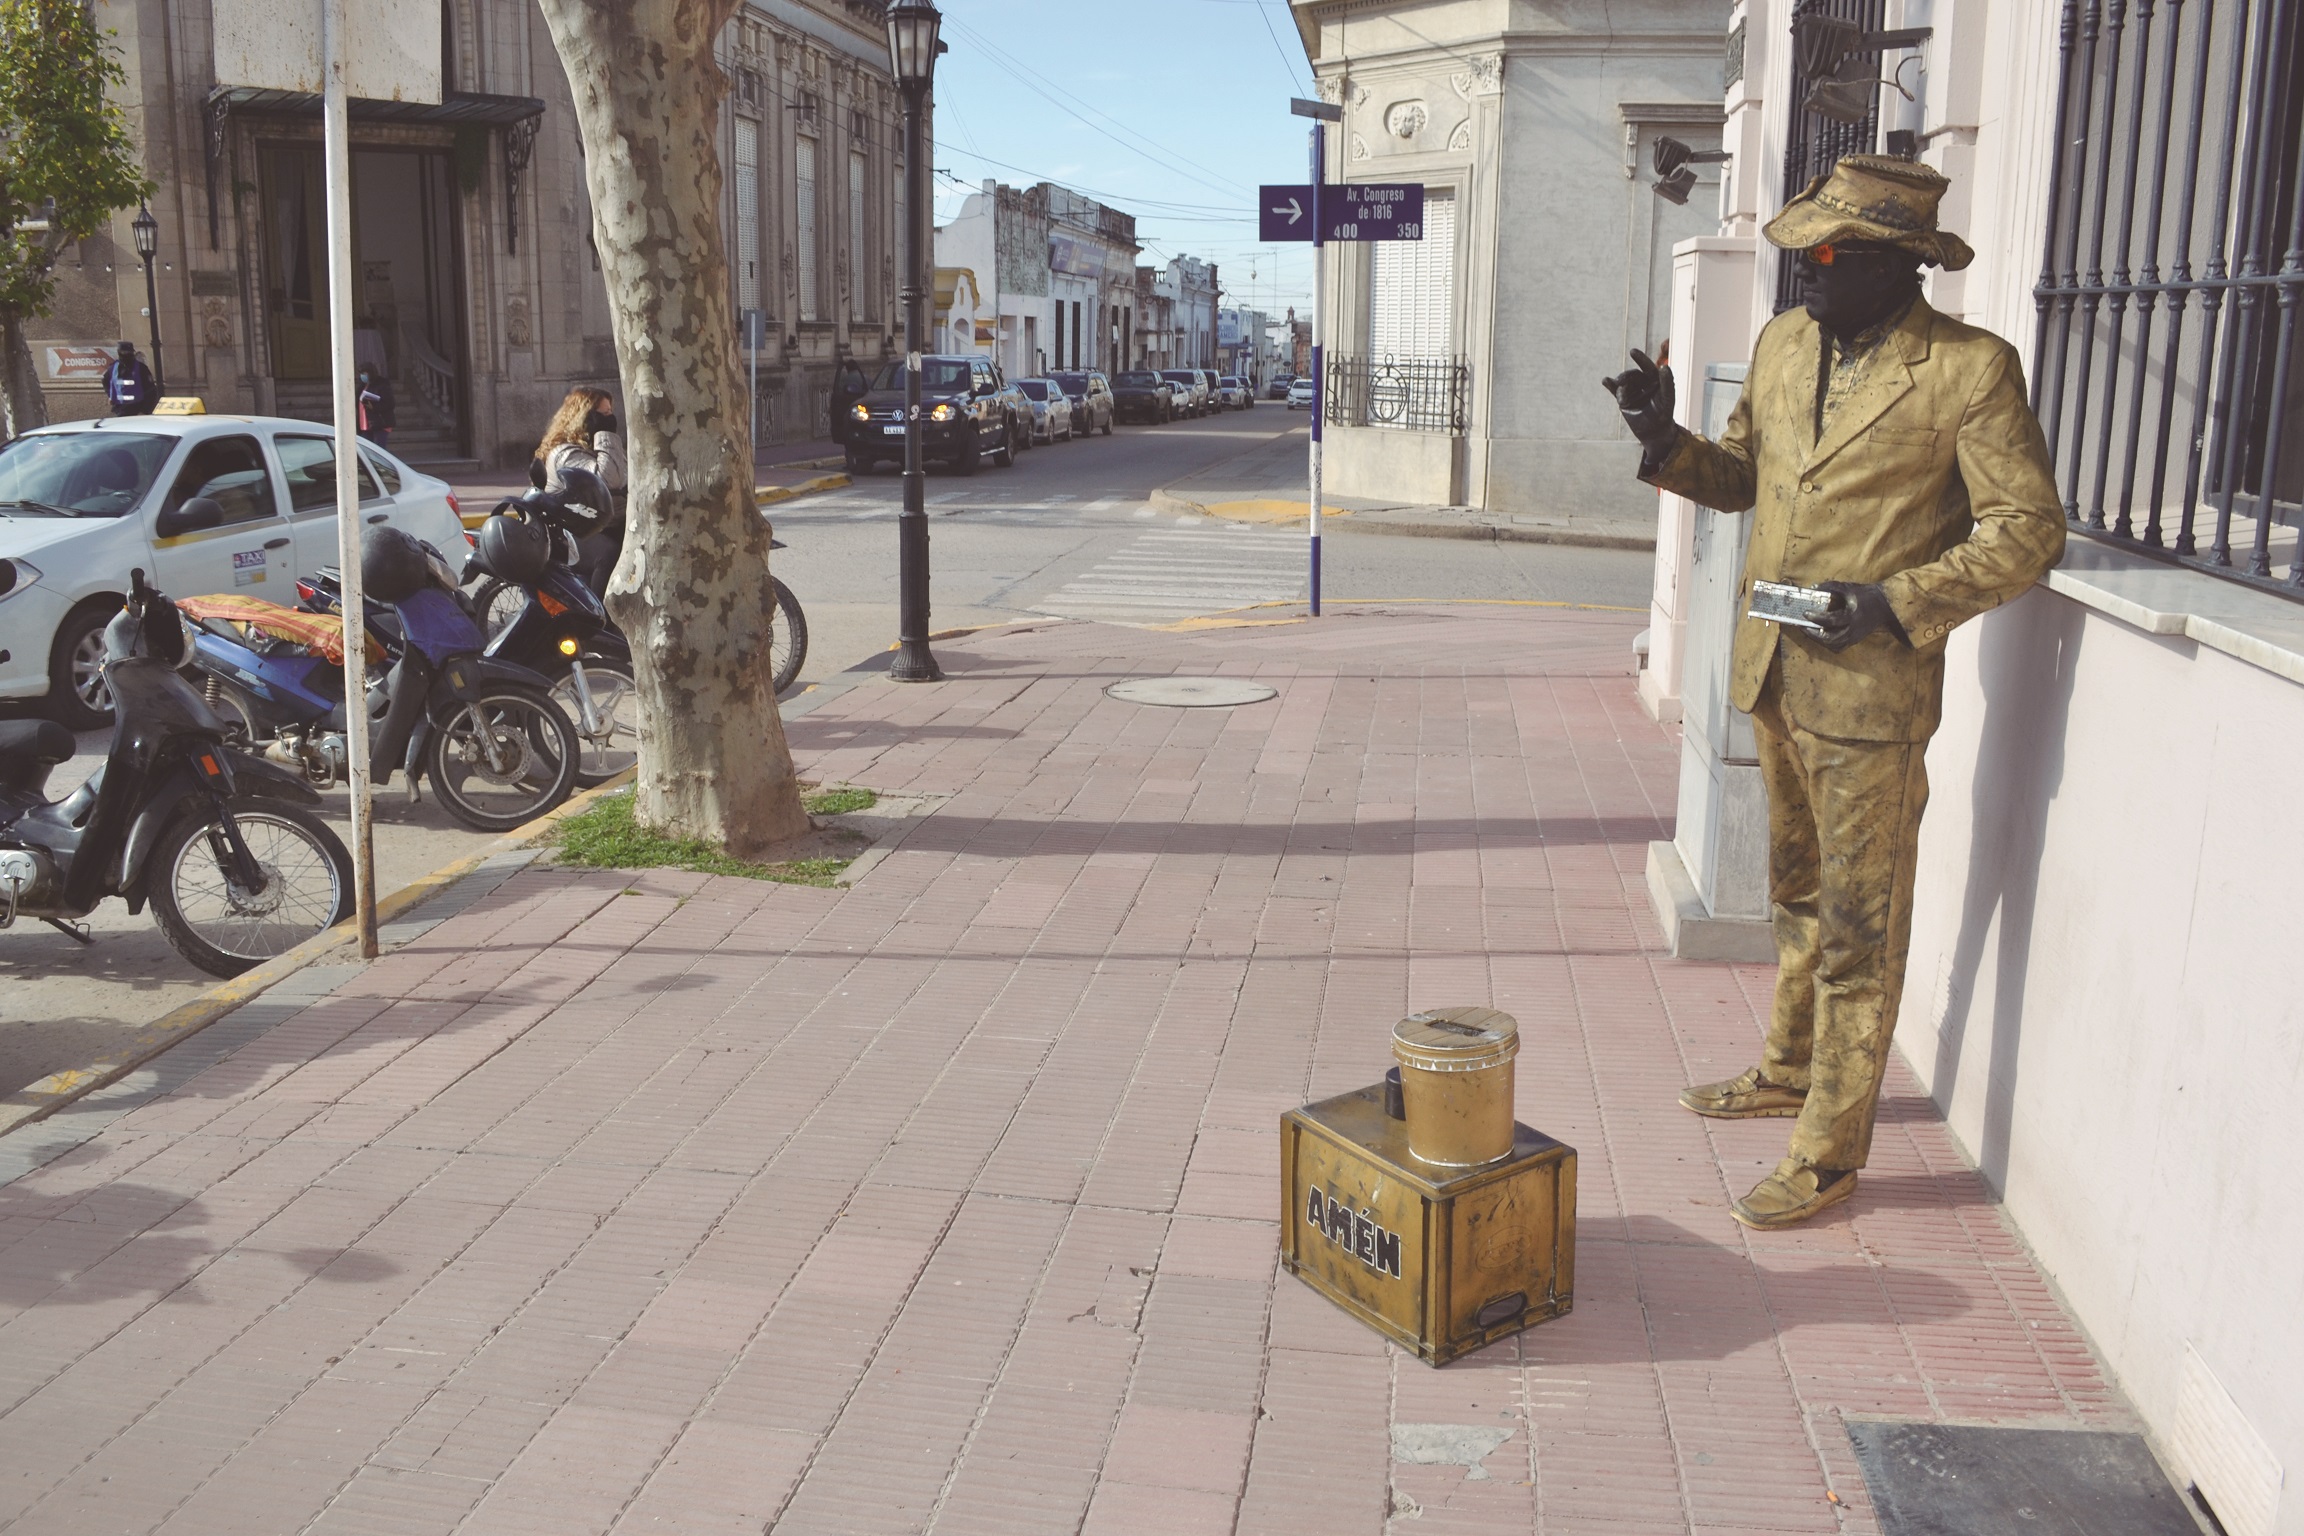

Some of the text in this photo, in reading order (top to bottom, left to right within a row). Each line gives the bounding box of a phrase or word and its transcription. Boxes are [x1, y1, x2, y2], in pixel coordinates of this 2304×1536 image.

[1346, 186, 1404, 204] Av. Congreso
[1358, 204, 1392, 219] de 1816
[1333, 222, 1419, 239] 400 350
[64, 357, 107, 367] CONGRESO
[240, 551, 265, 564] TAXI
[1306, 1184, 1401, 1280] AMÉN
